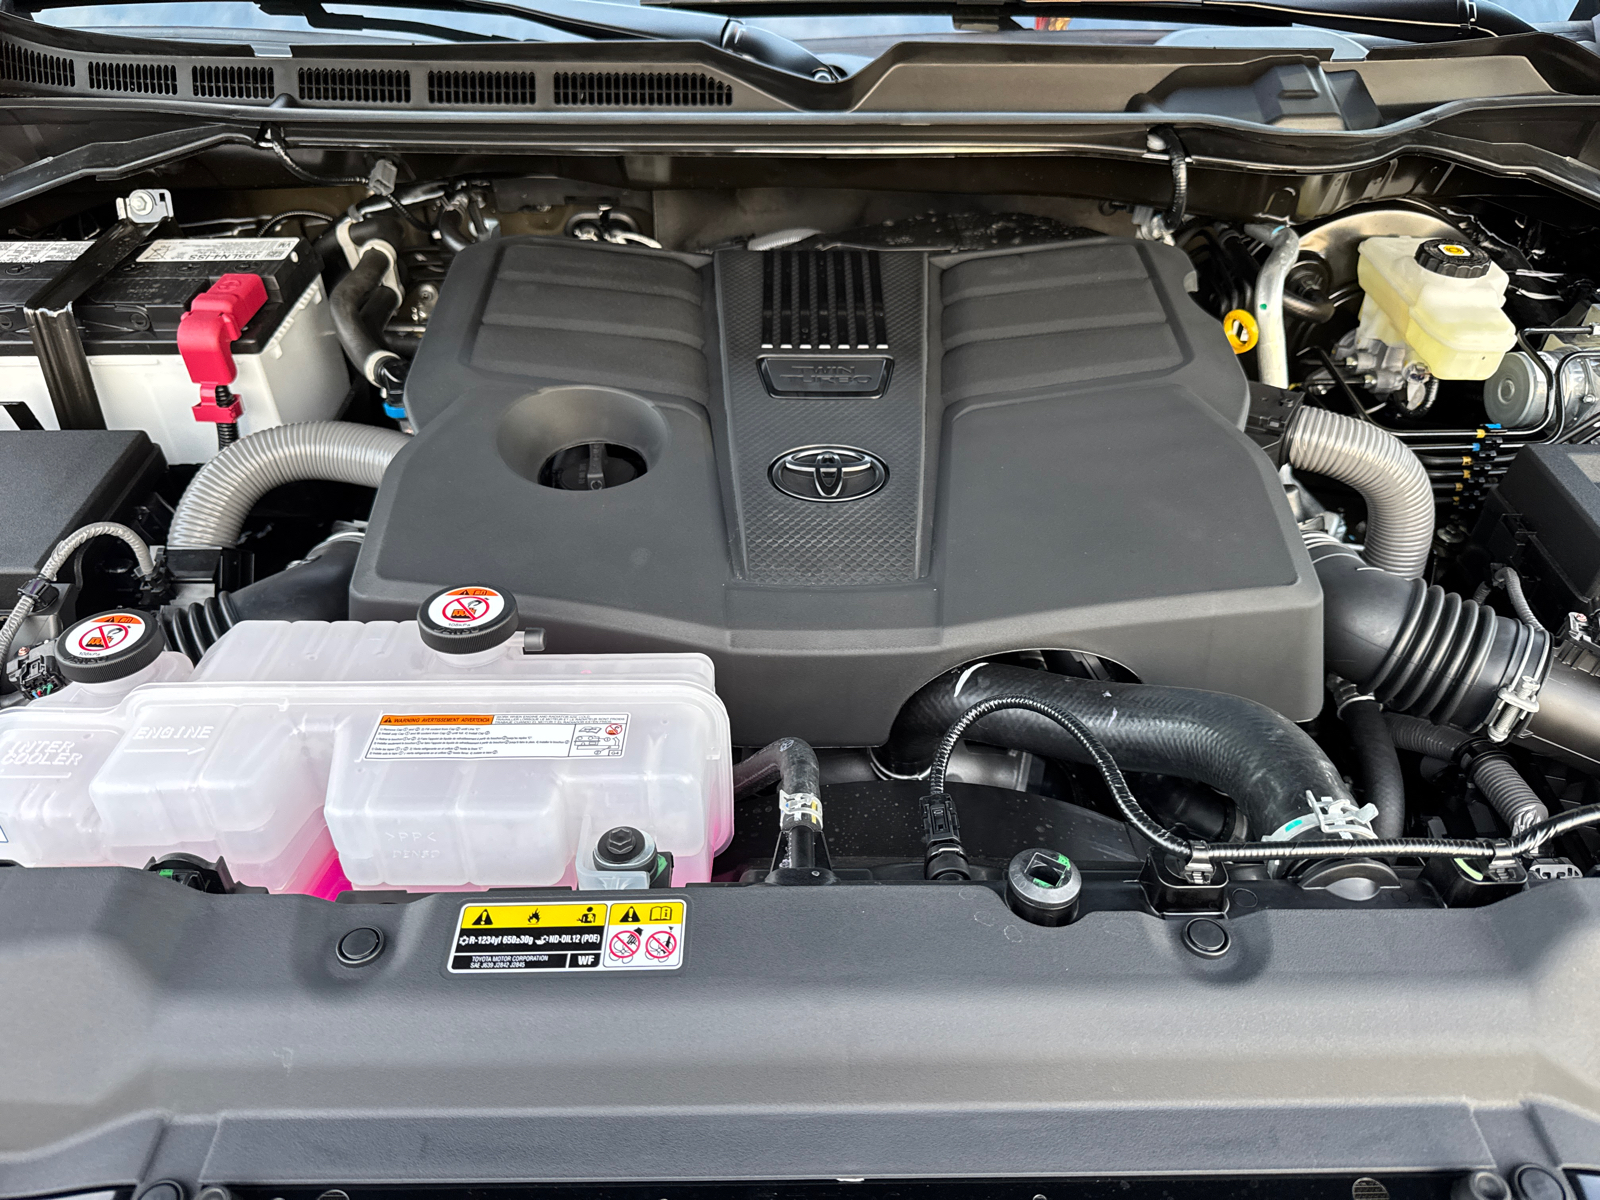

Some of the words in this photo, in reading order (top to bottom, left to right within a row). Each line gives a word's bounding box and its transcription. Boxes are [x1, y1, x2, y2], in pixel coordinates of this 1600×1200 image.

[791, 365, 855, 374] TWIN
[780, 375, 873, 384] TURBO
[133, 726, 214, 739] ENGINE
[9, 741, 75, 753] INTER
[1, 753, 83, 765] COOLER
[469, 935, 502, 945] R-1234yf
[502, 935, 534, 945] 650±30g
[581, 934, 600, 944] (POE)
[577, 955, 595, 965] WF
